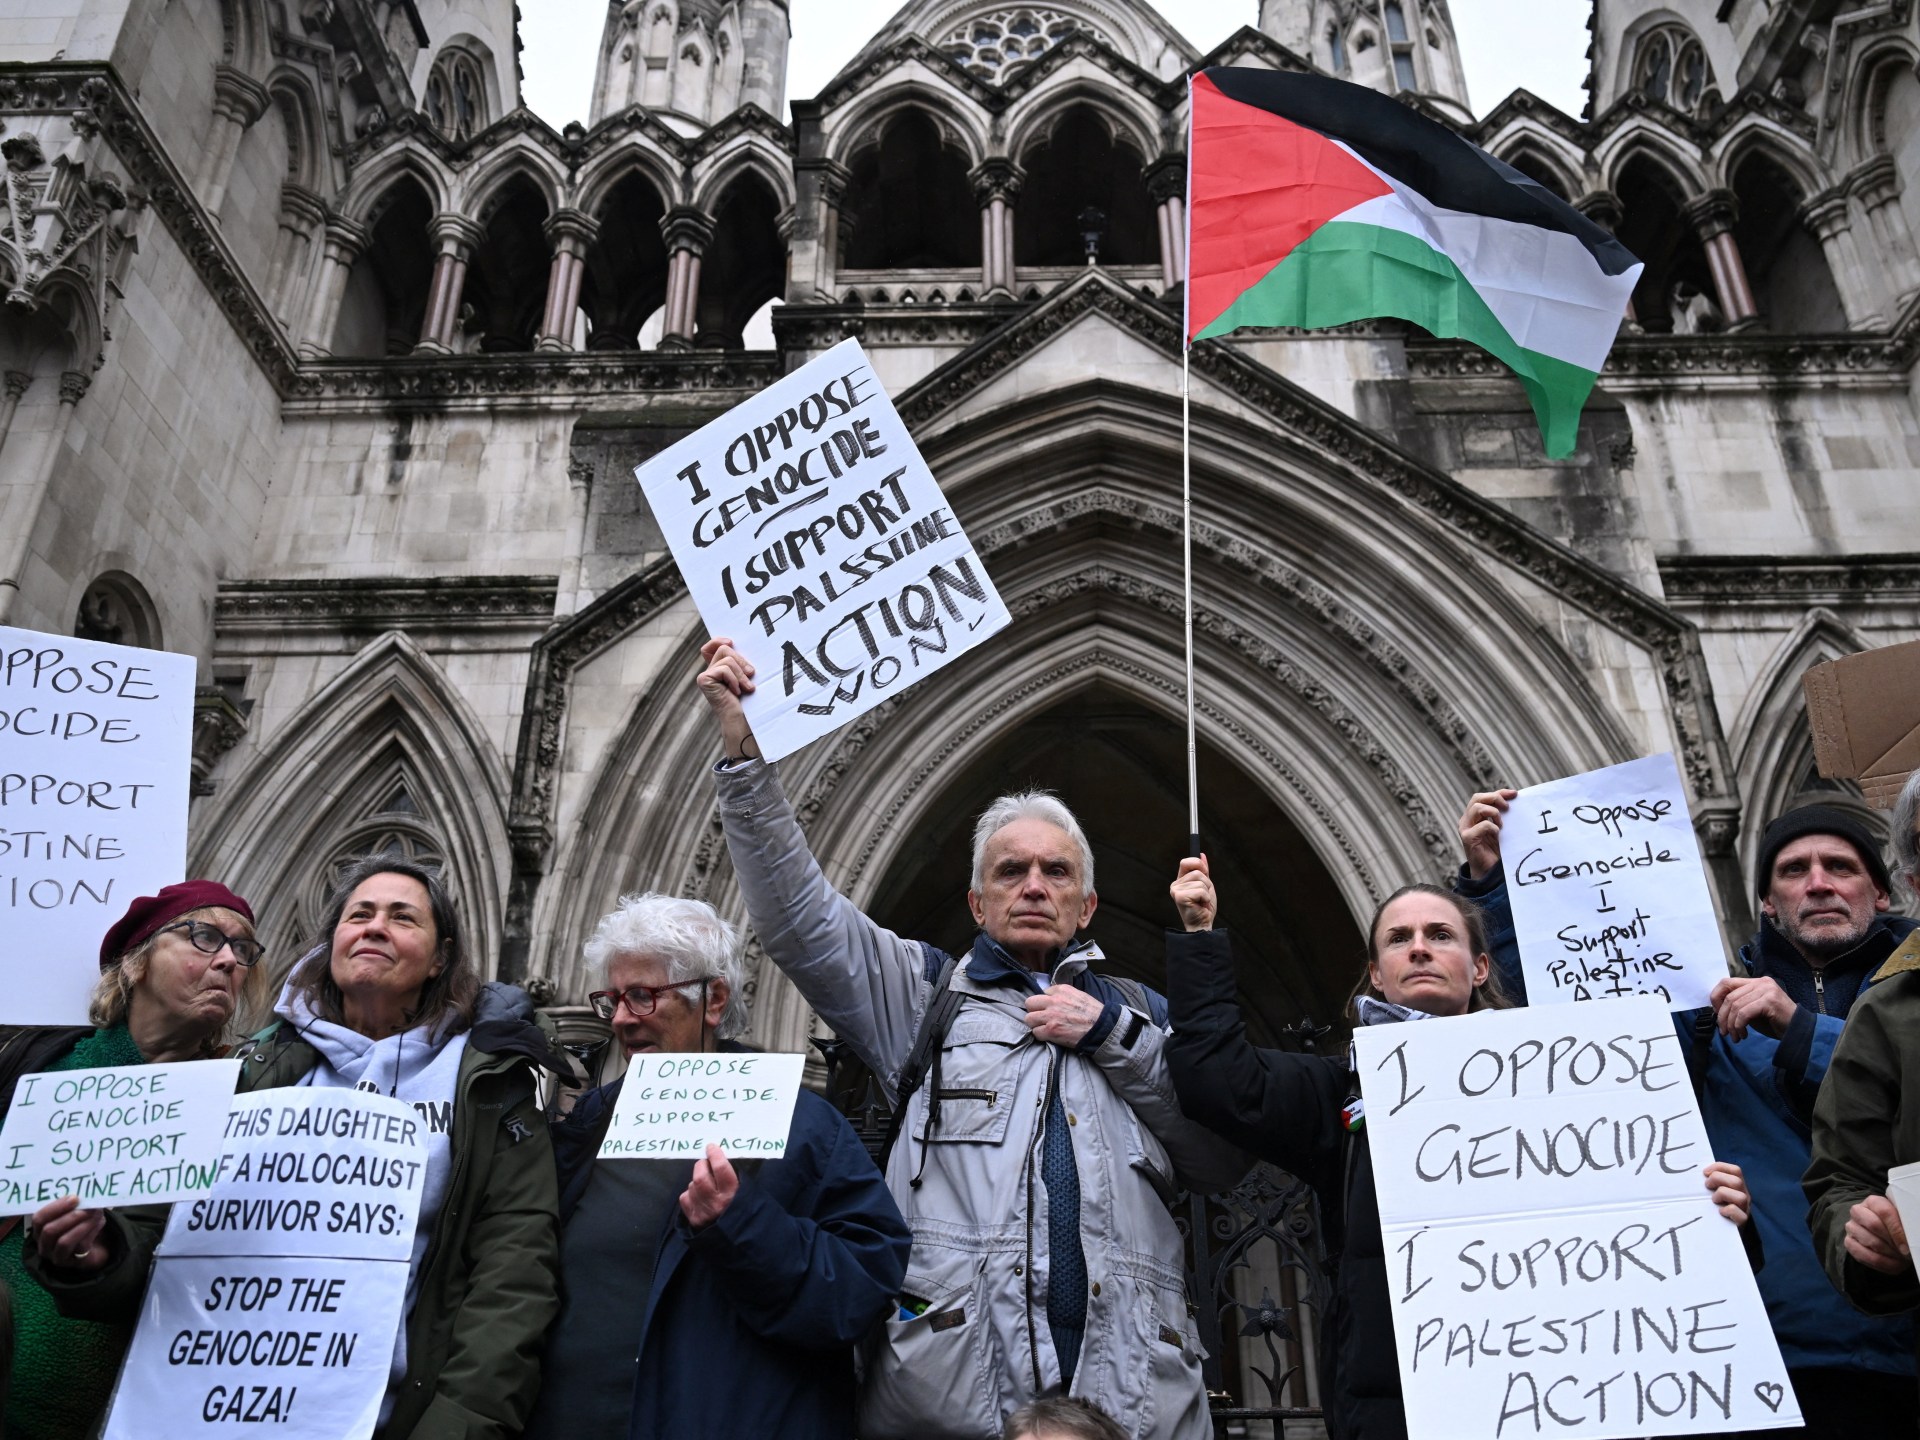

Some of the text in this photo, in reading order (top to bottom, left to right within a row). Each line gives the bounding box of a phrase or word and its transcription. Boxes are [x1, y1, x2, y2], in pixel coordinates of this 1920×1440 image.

[676, 365, 878, 507] I OPPOSE
[692, 416, 889, 549] GENOCIDE
[720, 465, 912, 609] I SUPPORT
[781, 556, 989, 697] ACTION
[0, 648, 159, 700] PPOSE
[1537, 799, 1672, 837] I Oppose
[1514, 840, 1681, 886] Genocide
[0, 877, 115, 909] ION
[1589, 880, 1616, 913] I
[1557, 907, 1651, 957] Support
[1546, 943, 1684, 988] Palestine
[638, 1058, 759, 1079] I OPPOSE
[1377, 1034, 1681, 1116] I OPPOSE
[17, 1073, 168, 1107] I OPPOSE
[48, 1100, 184, 1133] GENOCIDE
[224, 1107, 417, 1147] THIS DAUGHTER
[633, 1110, 735, 1127] SUPPORT
[5, 1132, 187, 1170] I SUPPORT
[603, 1136, 785, 1155] PALESTINE ACTION
[1415, 1110, 1699, 1185] GENOCIDE
[232, 1153, 250, 1182] A
[257, 1151, 421, 1191] HOLOCAUST
[187, 1199, 404, 1236] SURVIVOR SAYS:
[1397, 1216, 1703, 1304] I SUPPORT
[204, 1276, 346, 1313] STOP THE
[167, 1329, 357, 1368] GENOCIDE IN
[1413, 1299, 1738, 1373] PALESTINE
[201, 1385, 297, 1424] GAZA!
[1497, 1363, 1732, 1439] ACTION
